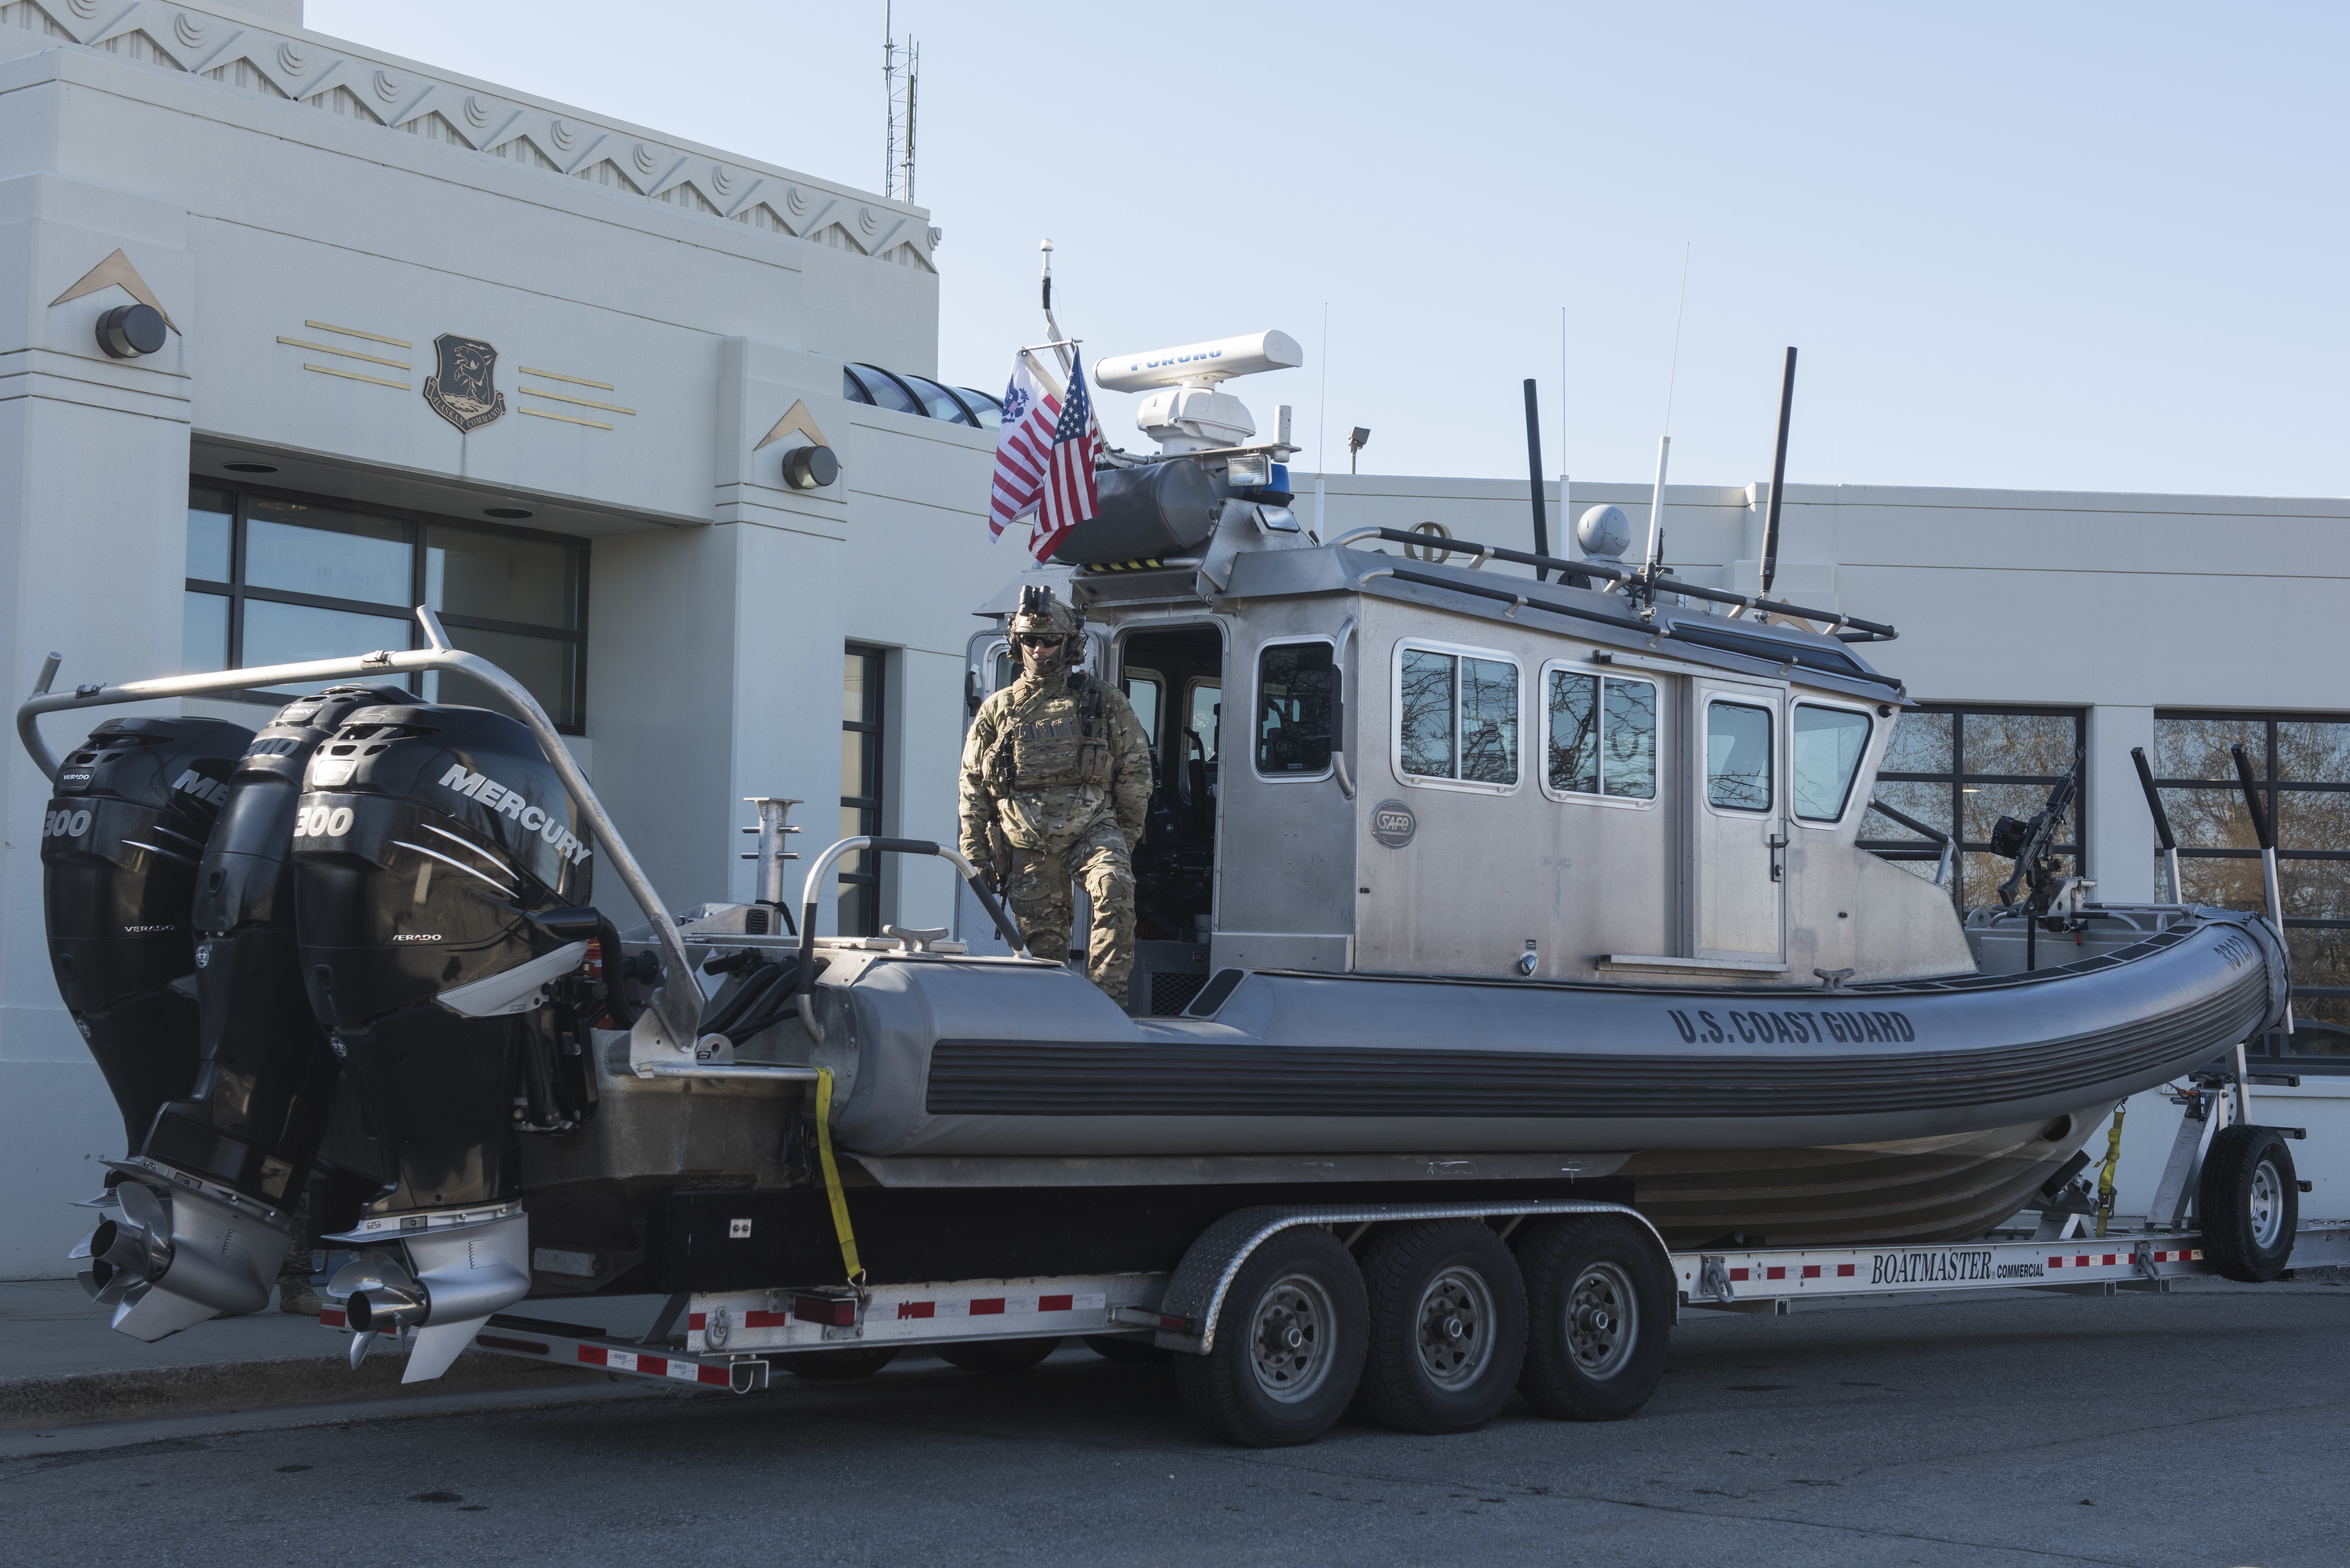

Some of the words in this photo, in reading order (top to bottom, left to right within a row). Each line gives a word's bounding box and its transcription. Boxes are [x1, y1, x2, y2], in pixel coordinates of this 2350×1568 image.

[1131, 346, 1222, 371] FURUNO
[432, 397, 465, 426] ALASKAN
[467, 407, 500, 428] COMMAND
[240, 736, 302, 759] 300
[43, 810, 92, 838] 300
[294, 807, 354, 837] 300
[438, 764, 592, 866] MERCURY
[2213, 935, 2254, 971] 33127
[1729, 1011, 1823, 1043] COAST
[1821, 1011, 1915, 1043] GUARD
[1997, 1264, 2044, 1278] COMMERCIAL
